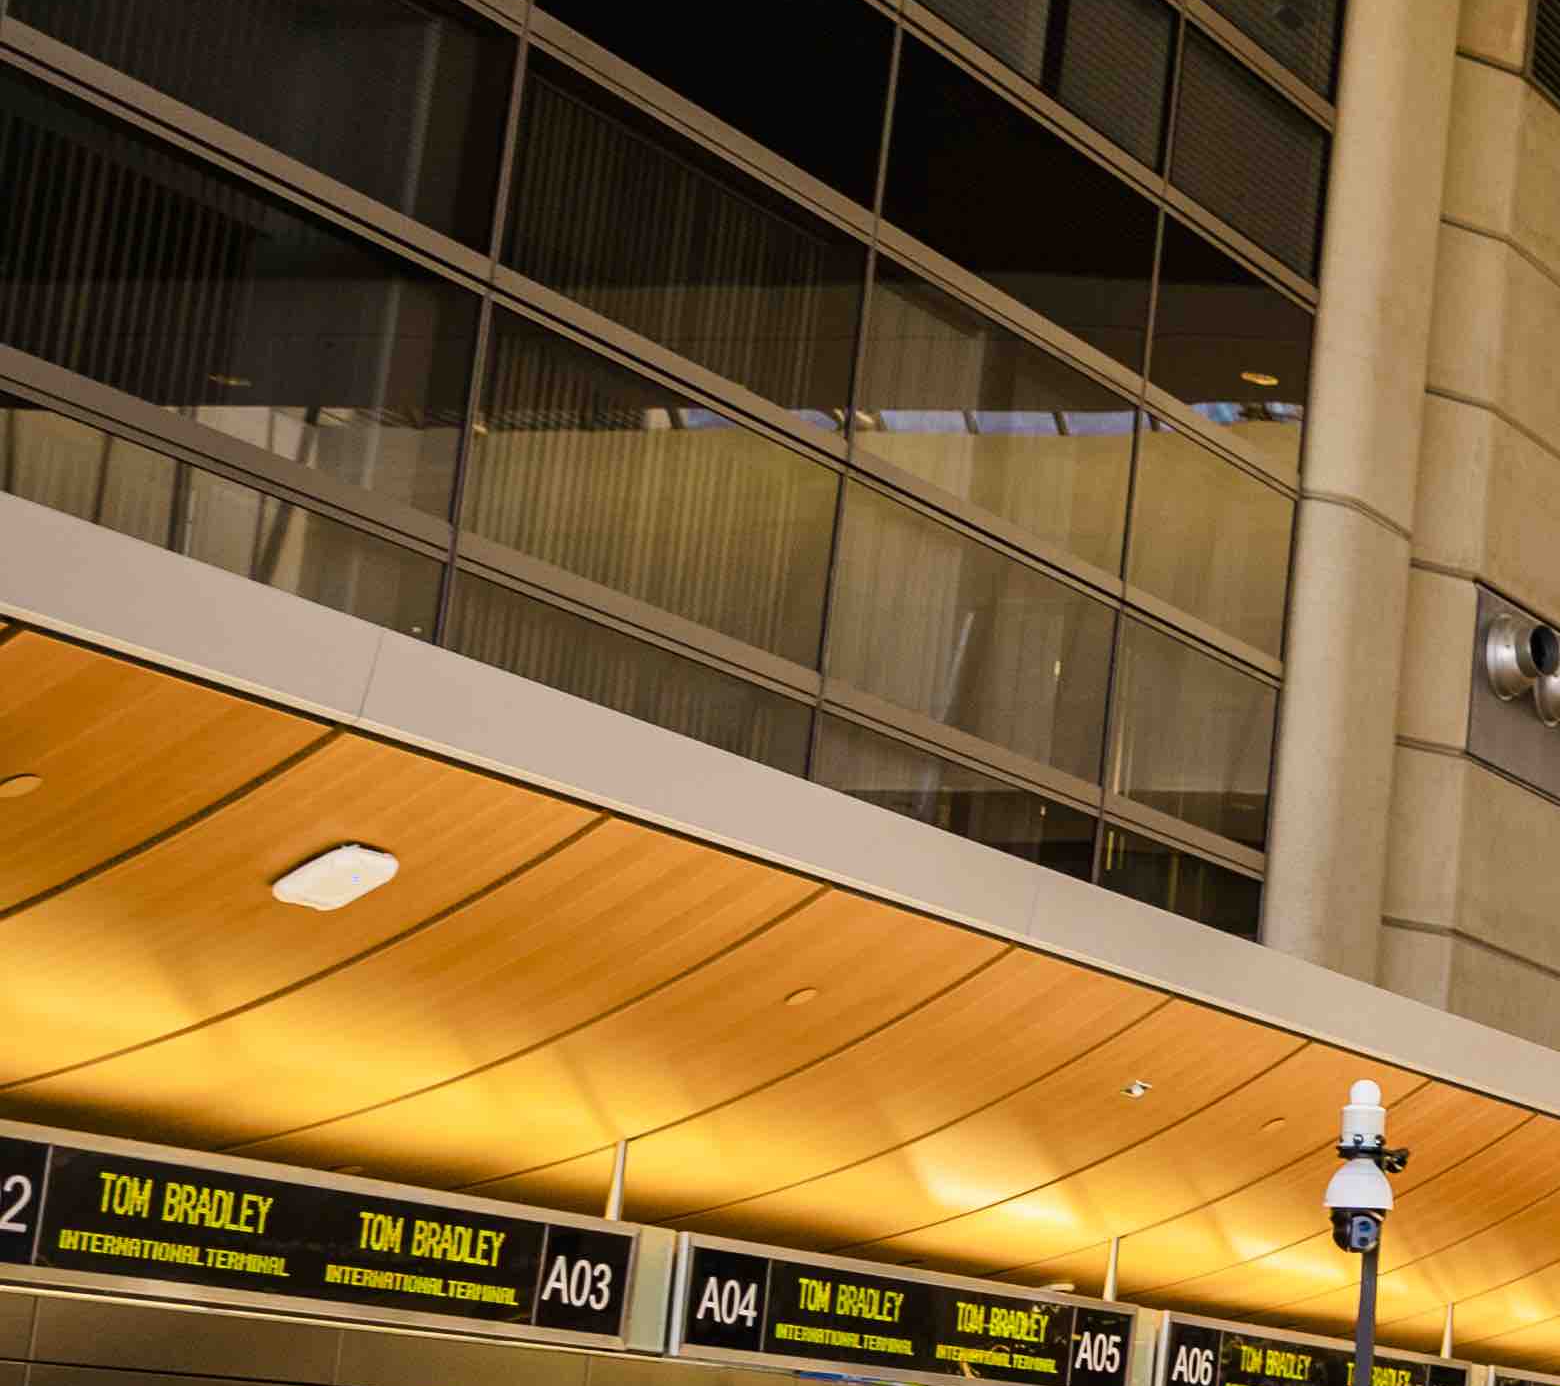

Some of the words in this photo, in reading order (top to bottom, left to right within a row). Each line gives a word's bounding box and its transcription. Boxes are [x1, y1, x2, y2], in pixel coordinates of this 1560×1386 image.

[100, 1172, 151, 1218] TOM
[162, 1186, 272, 1235] BRADLEY
[59, 1229, 201, 1266] INTERNATIONAL
[204, 1249, 289, 1277] TERMINAL
[360, 1212, 404, 1252] TOM
[412, 1222, 504, 1268] BRADLEY
[325, 1264, 447, 1298] INTERNATIONAL
[447, 1282, 518, 1306] TERMINAL
[541, 1254, 611, 1311] A03
[697, 1276, 757, 1328] A04
[799, 1277, 830, 1313] TOM
[836, 1284, 904, 1324] BRADLEY
[775, 1322, 861, 1349] INTERNATIONAL
[956, 1301, 984, 1334] TOM
[988, 1306, 1048, 1343] BRADLEY
[1075, 1330, 1120, 1374] A05
[1171, 1345, 1213, 1386] A06
[1265, 1348, 1311, 1380] BRADLEY
